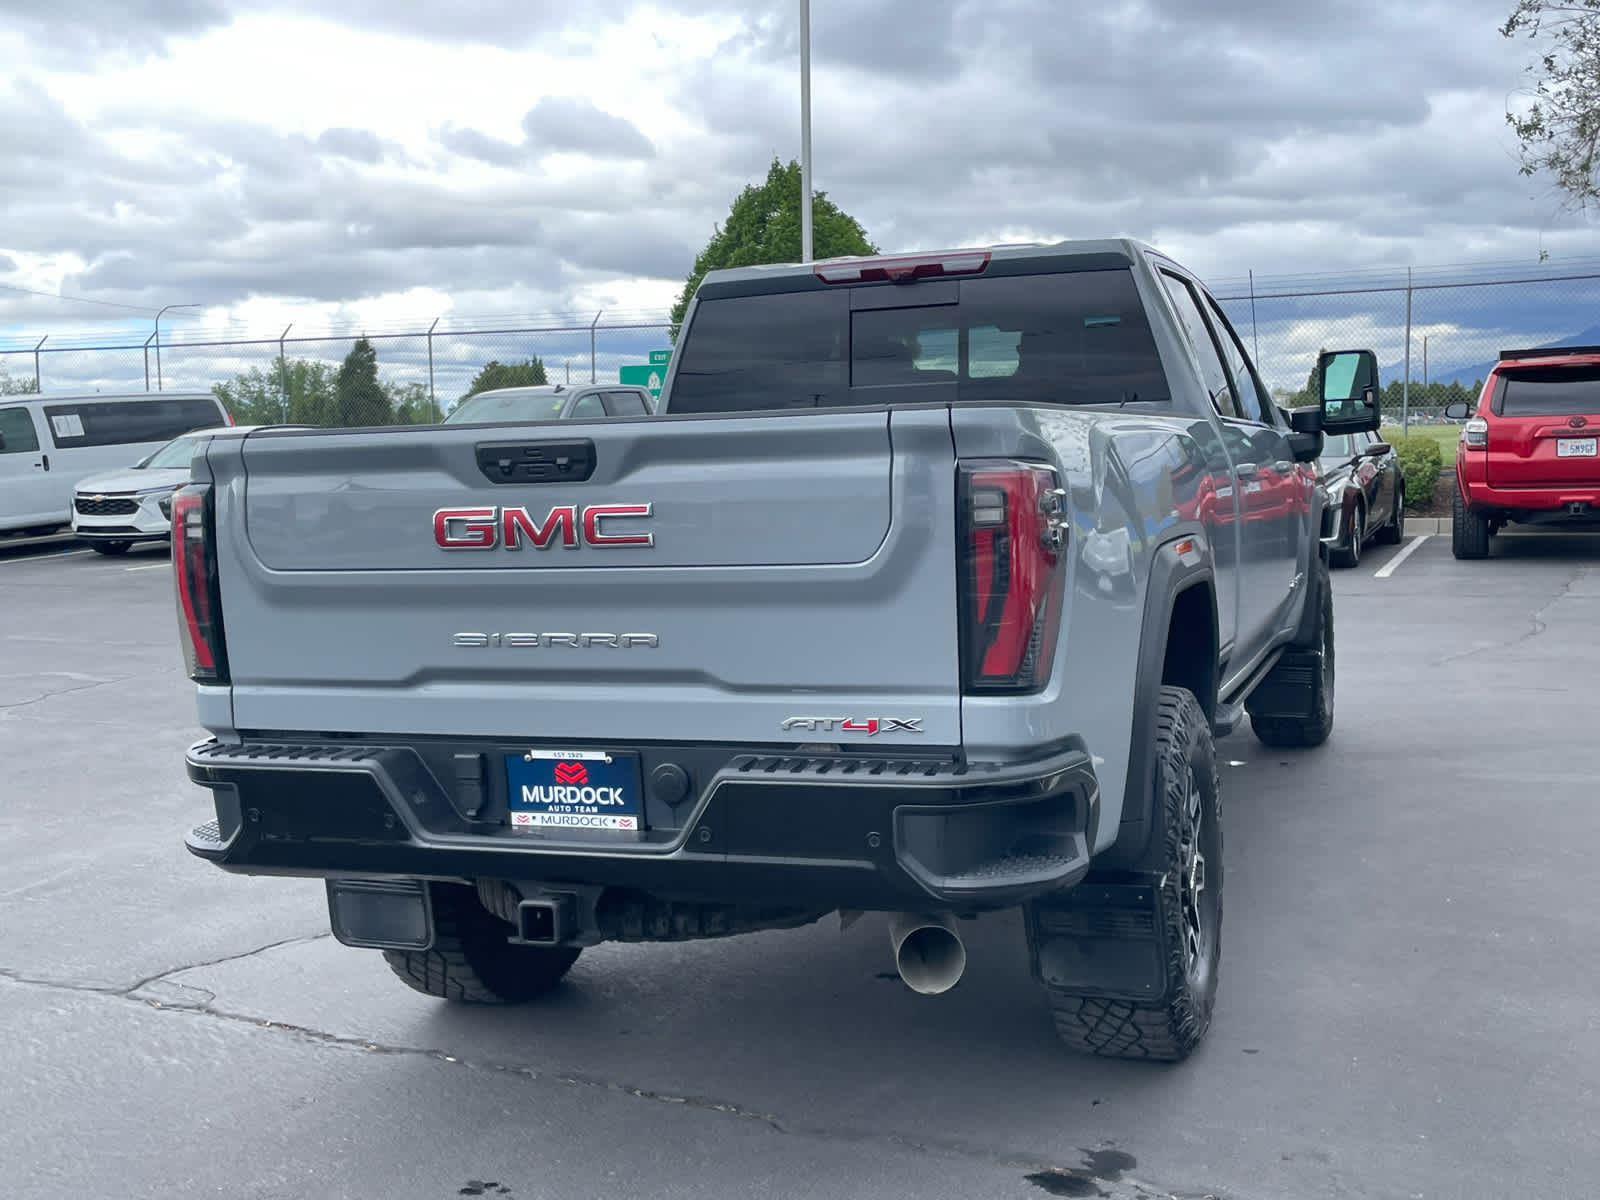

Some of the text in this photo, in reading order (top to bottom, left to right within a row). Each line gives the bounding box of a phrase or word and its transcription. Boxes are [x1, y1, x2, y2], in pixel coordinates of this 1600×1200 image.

[433, 502, 655, 551] GMC
[452, 632, 660, 649] SIERRA
[781, 716, 924, 736] AT4X
[521, 785, 625, 806] MURDOCK
[548, 805, 598, 814] AUTO TEAM
[540, 815, 609, 827] MURDOCK
